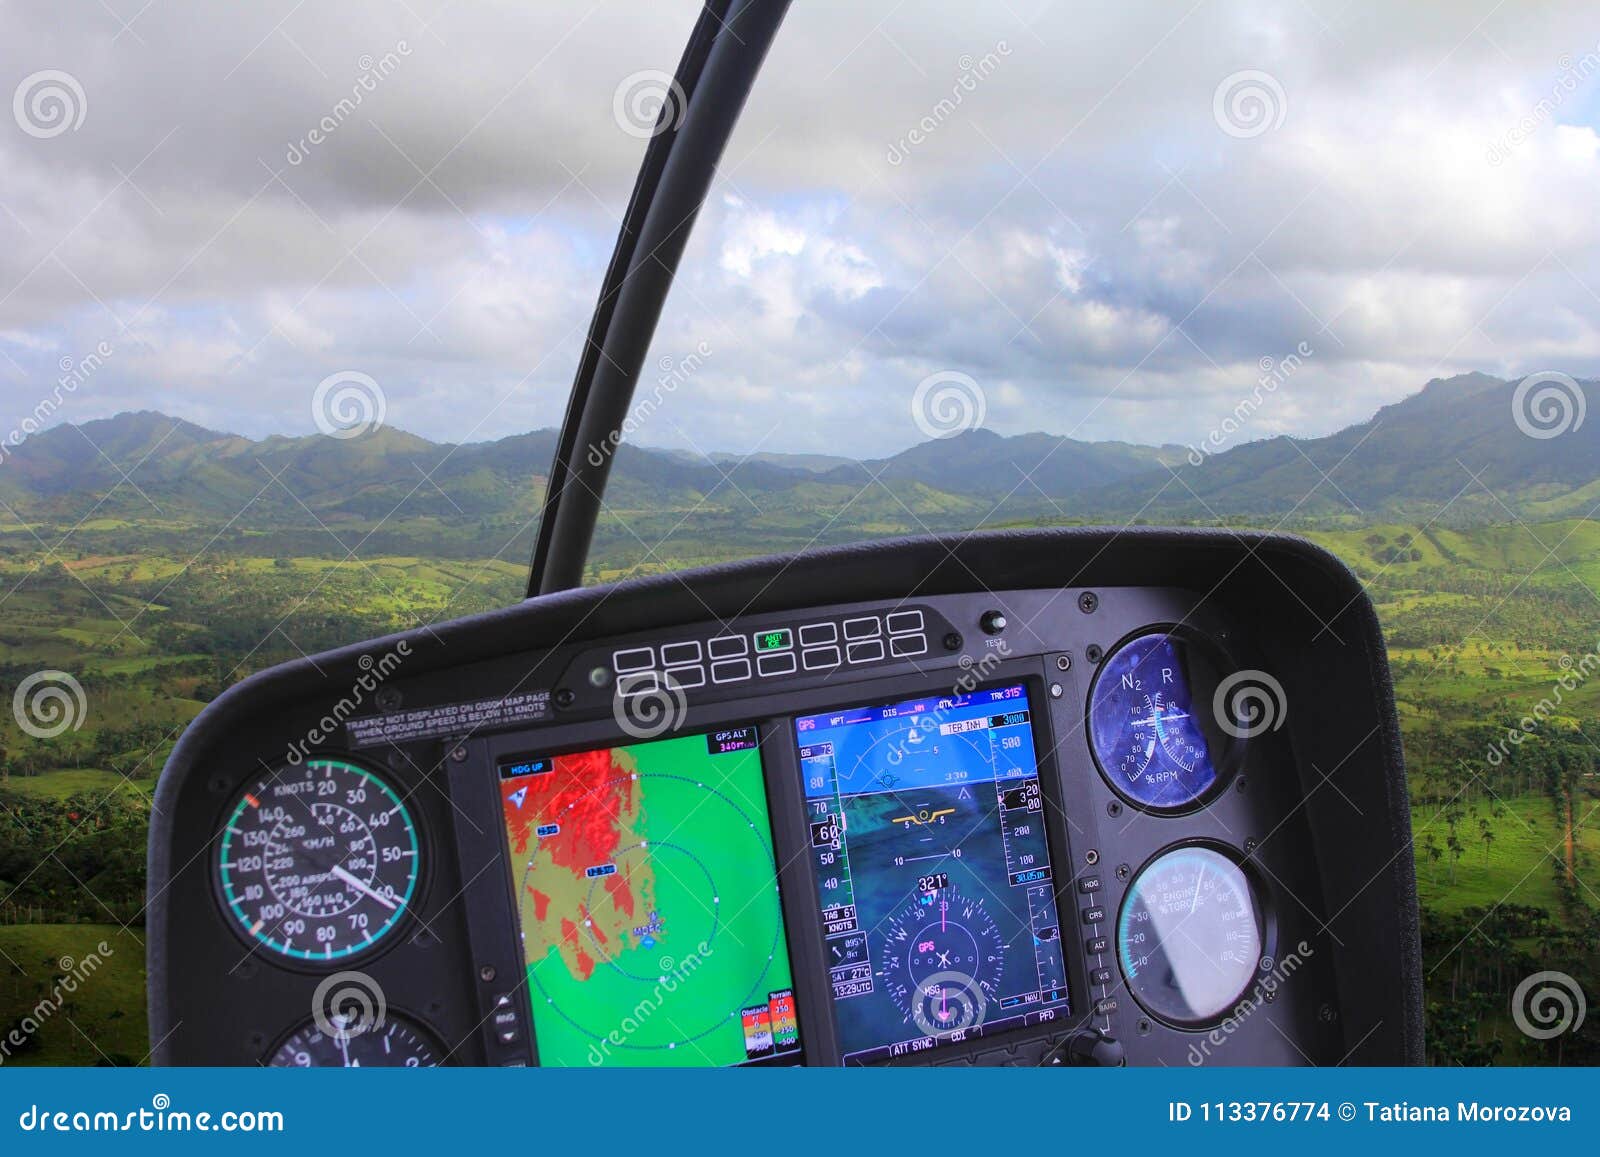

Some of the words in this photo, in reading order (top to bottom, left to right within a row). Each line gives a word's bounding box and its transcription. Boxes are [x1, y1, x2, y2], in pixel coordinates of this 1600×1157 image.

[764, 634, 782, 642] ANTI
[768, 640, 780, 648] ICE
[986, 638, 1002, 648] TEST
[1162, 668, 1174, 684] R
[346, 716, 384, 730] TRAFFIC
[386, 714, 406, 724] NOT
[408, 706, 458, 722] DISPLAYED
[460, 704, 474, 714] ON
[504, 696, 524, 706] MAP
[526, 692, 550, 703] PAGE
[798, 720, 816, 731] GPS
[830, 716, 844, 726] WPT
[882, 708, 897, 718] DIS
[938, 700, 953, 709] DTK
[990, 692, 1004, 700] TRK
[1131, 706, 1140, 715] 110
[1166, 701, 1176, 710] 110
[354, 726, 384, 739] WHEN
[384, 720, 424, 736] GROUND
[426, 714, 456, 729] SPEED
[458, 714, 468, 723] IS
[468, 708, 502, 722] BELOW
[504, 706, 514, 716] 15
[516, 702, 546, 714] KNOTS
[1003, 713, 1024, 725] 3000
[948, 722, 962, 734] TER
[966, 720, 980, 730] INH
[716, 732, 732, 742] GPS
[733, 730, 748, 739] ALT
[1134, 732, 1144, 741] 90
[1176, 738, 1184, 746] 80
[1002, 736, 1021, 749] 500
[800, 749, 812, 758] GS
[822, 745, 832, 754] 73
[934, 746, 939, 754] 5
[1132, 746, 1142, 754] 80
[1185, 746, 1194, 754] 70
[1194, 751, 1204, 760] 60
[1126, 756, 1136, 764] 70
[511, 764, 530, 775] HDG
[532, 762, 544, 772] UP
[1121, 764, 1126, 772] 0
[274, 782, 315, 796] KNOTS
[318, 780, 336, 796] 20
[810, 777, 824, 789] 80
[1026, 784, 1038, 796] 20
[347, 790, 366, 804] 30
[1020, 792, 1026, 802] 3
[814, 802, 828, 814] 70
[1028, 798, 1040, 810] 00
[258, 807, 284, 822] 140
[318, 815, 334, 826] 40
[370, 812, 390, 828] 40
[940, 816, 945, 824] 5
[340, 822, 356, 833] 60
[820, 824, 839, 840] 60
[1014, 826, 1030, 836] 200
[244, 831, 268, 848] 130
[302, 837, 335, 850] KM/H
[382, 846, 402, 862] 50
[820, 852, 834, 865] 50
[952, 848, 961, 858] 10
[238, 856, 262, 872] 120
[272, 858, 294, 870] 220
[348, 859, 368, 870] 100
[894, 856, 904, 866] 10
[1020, 854, 1034, 865] 100
[824, 878, 838, 890] 40
[918, 874, 948, 891] 321°
[1084, 880, 1100, 889] HDG
[1204, 880, 1215, 890] 80
[324, 892, 344, 904] 140
[1039, 888, 1044, 897] 2
[260, 904, 284, 920] 100
[824, 910, 838, 920] TAS
[844, 908, 855, 918] 61
[914, 908, 925, 920] 30
[963, 908, 974, 920] N
[1043, 911, 1048, 920] 1
[1089, 911, 1103, 920] CRS
[1137, 912, 1148, 922] 30
[1222, 910, 1236, 922] 100
[284, 920, 305, 934] 90
[348, 914, 368, 930] 70
[828, 920, 852, 932] KNOTS
[316, 926, 336, 942] 80
[896, 929, 908, 942] W
[982, 928, 990, 936] 3
[1134, 932, 1145, 944] 20
[1226, 931, 1238, 941] 110
[918, 940, 935, 952] GPS
[1094, 941, 1105, 950] ALT
[890, 956, 900, 968] 24
[1050, 956, 1054, 966] 1
[1138, 956, 1148, 966] 10
[1220, 950, 1234, 962] 120
[832, 972, 845, 982] SAT
[852, 968, 870, 979] 27°C
[834, 982, 871, 997] 13:29UTC
[924, 984, 940, 996] MSG
[980, 980, 991, 992] E
[1052, 980, 1057, 989] 2
[770, 990, 792, 1000] Terrain
[1024, 994, 1038, 1004] NAV
[1052, 992, 1058, 1000] 0
[742, 1006, 768, 1017] Obstacle
[914, 1003, 924, 1014] S
[1040, 1010, 1055, 1022] PFD
[951, 1030, 966, 1042] CDI
[384, 1034, 390, 1054] 1
[894, 1043, 909, 1056] ATT
[912, 1038, 933, 1050] SYNC
